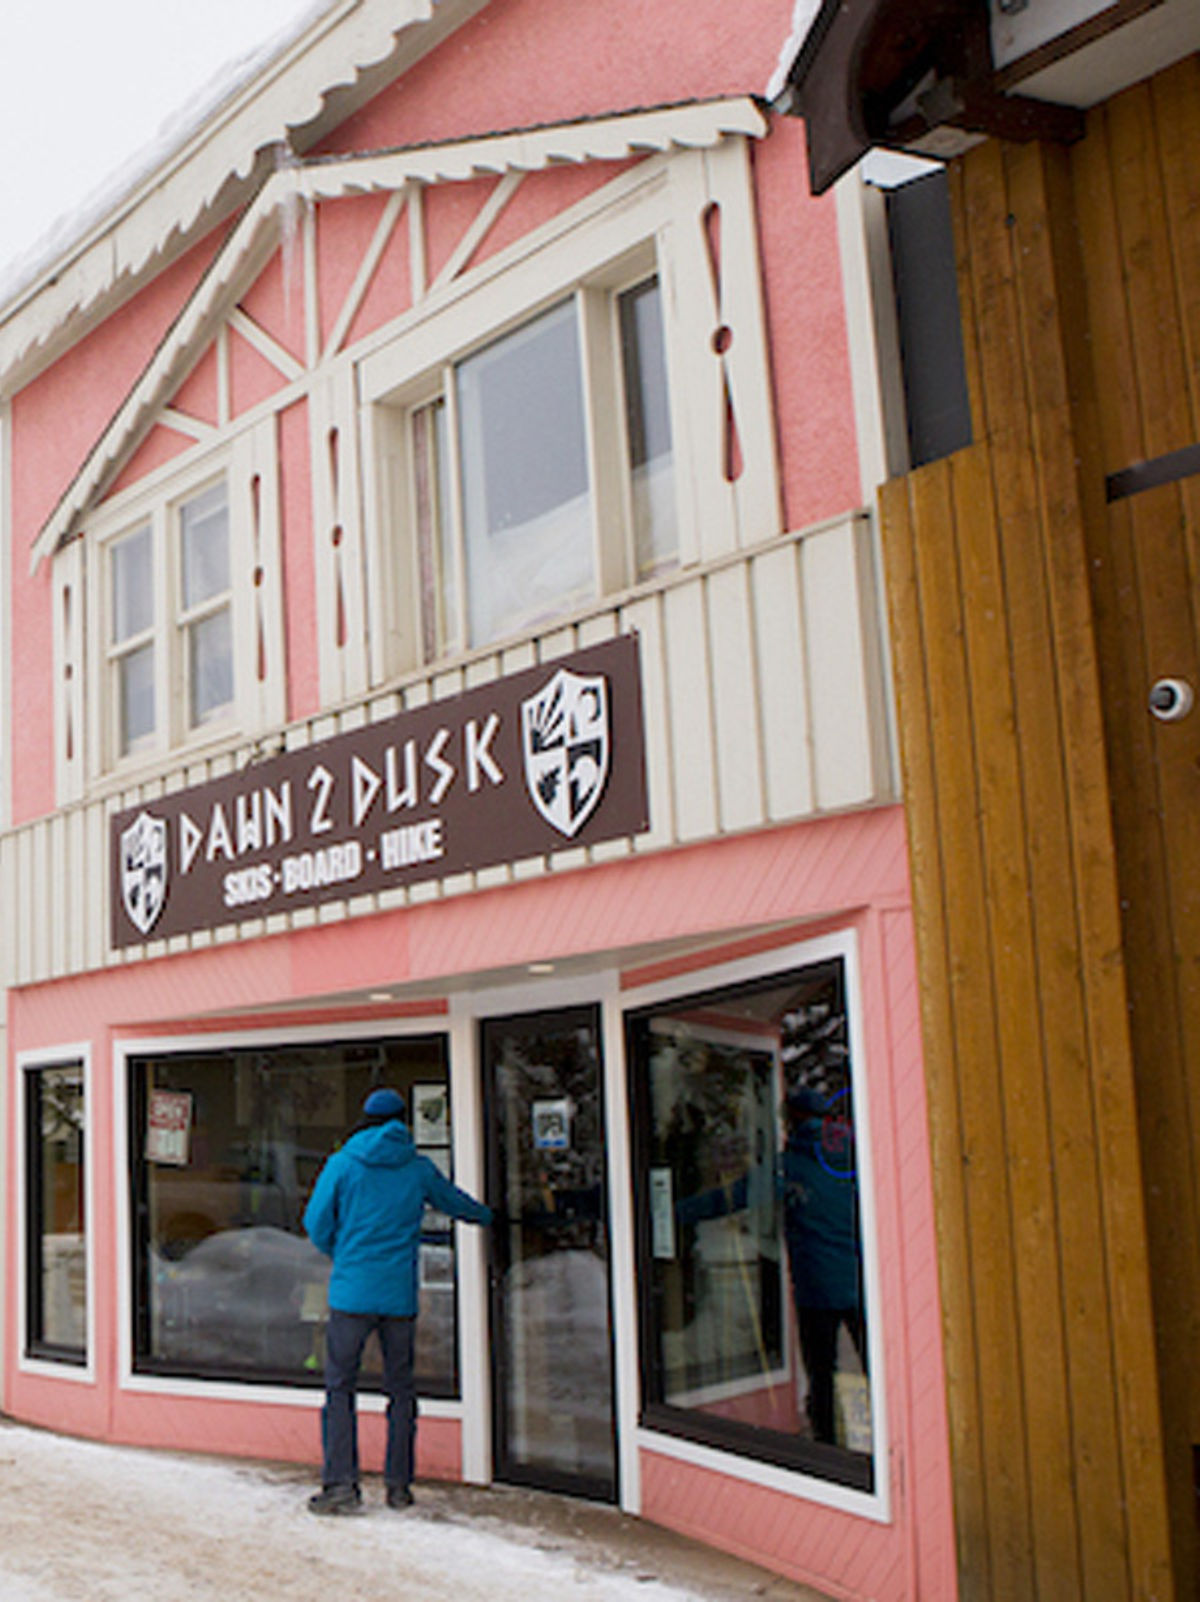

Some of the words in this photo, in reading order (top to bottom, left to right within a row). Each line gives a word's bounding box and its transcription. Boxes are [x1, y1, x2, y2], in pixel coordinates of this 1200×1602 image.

[179, 780, 292, 875] DAWN
[307, 764, 335, 834] 2
[352, 712, 504, 827] DUSK
[380, 818, 445, 870] HIKE
